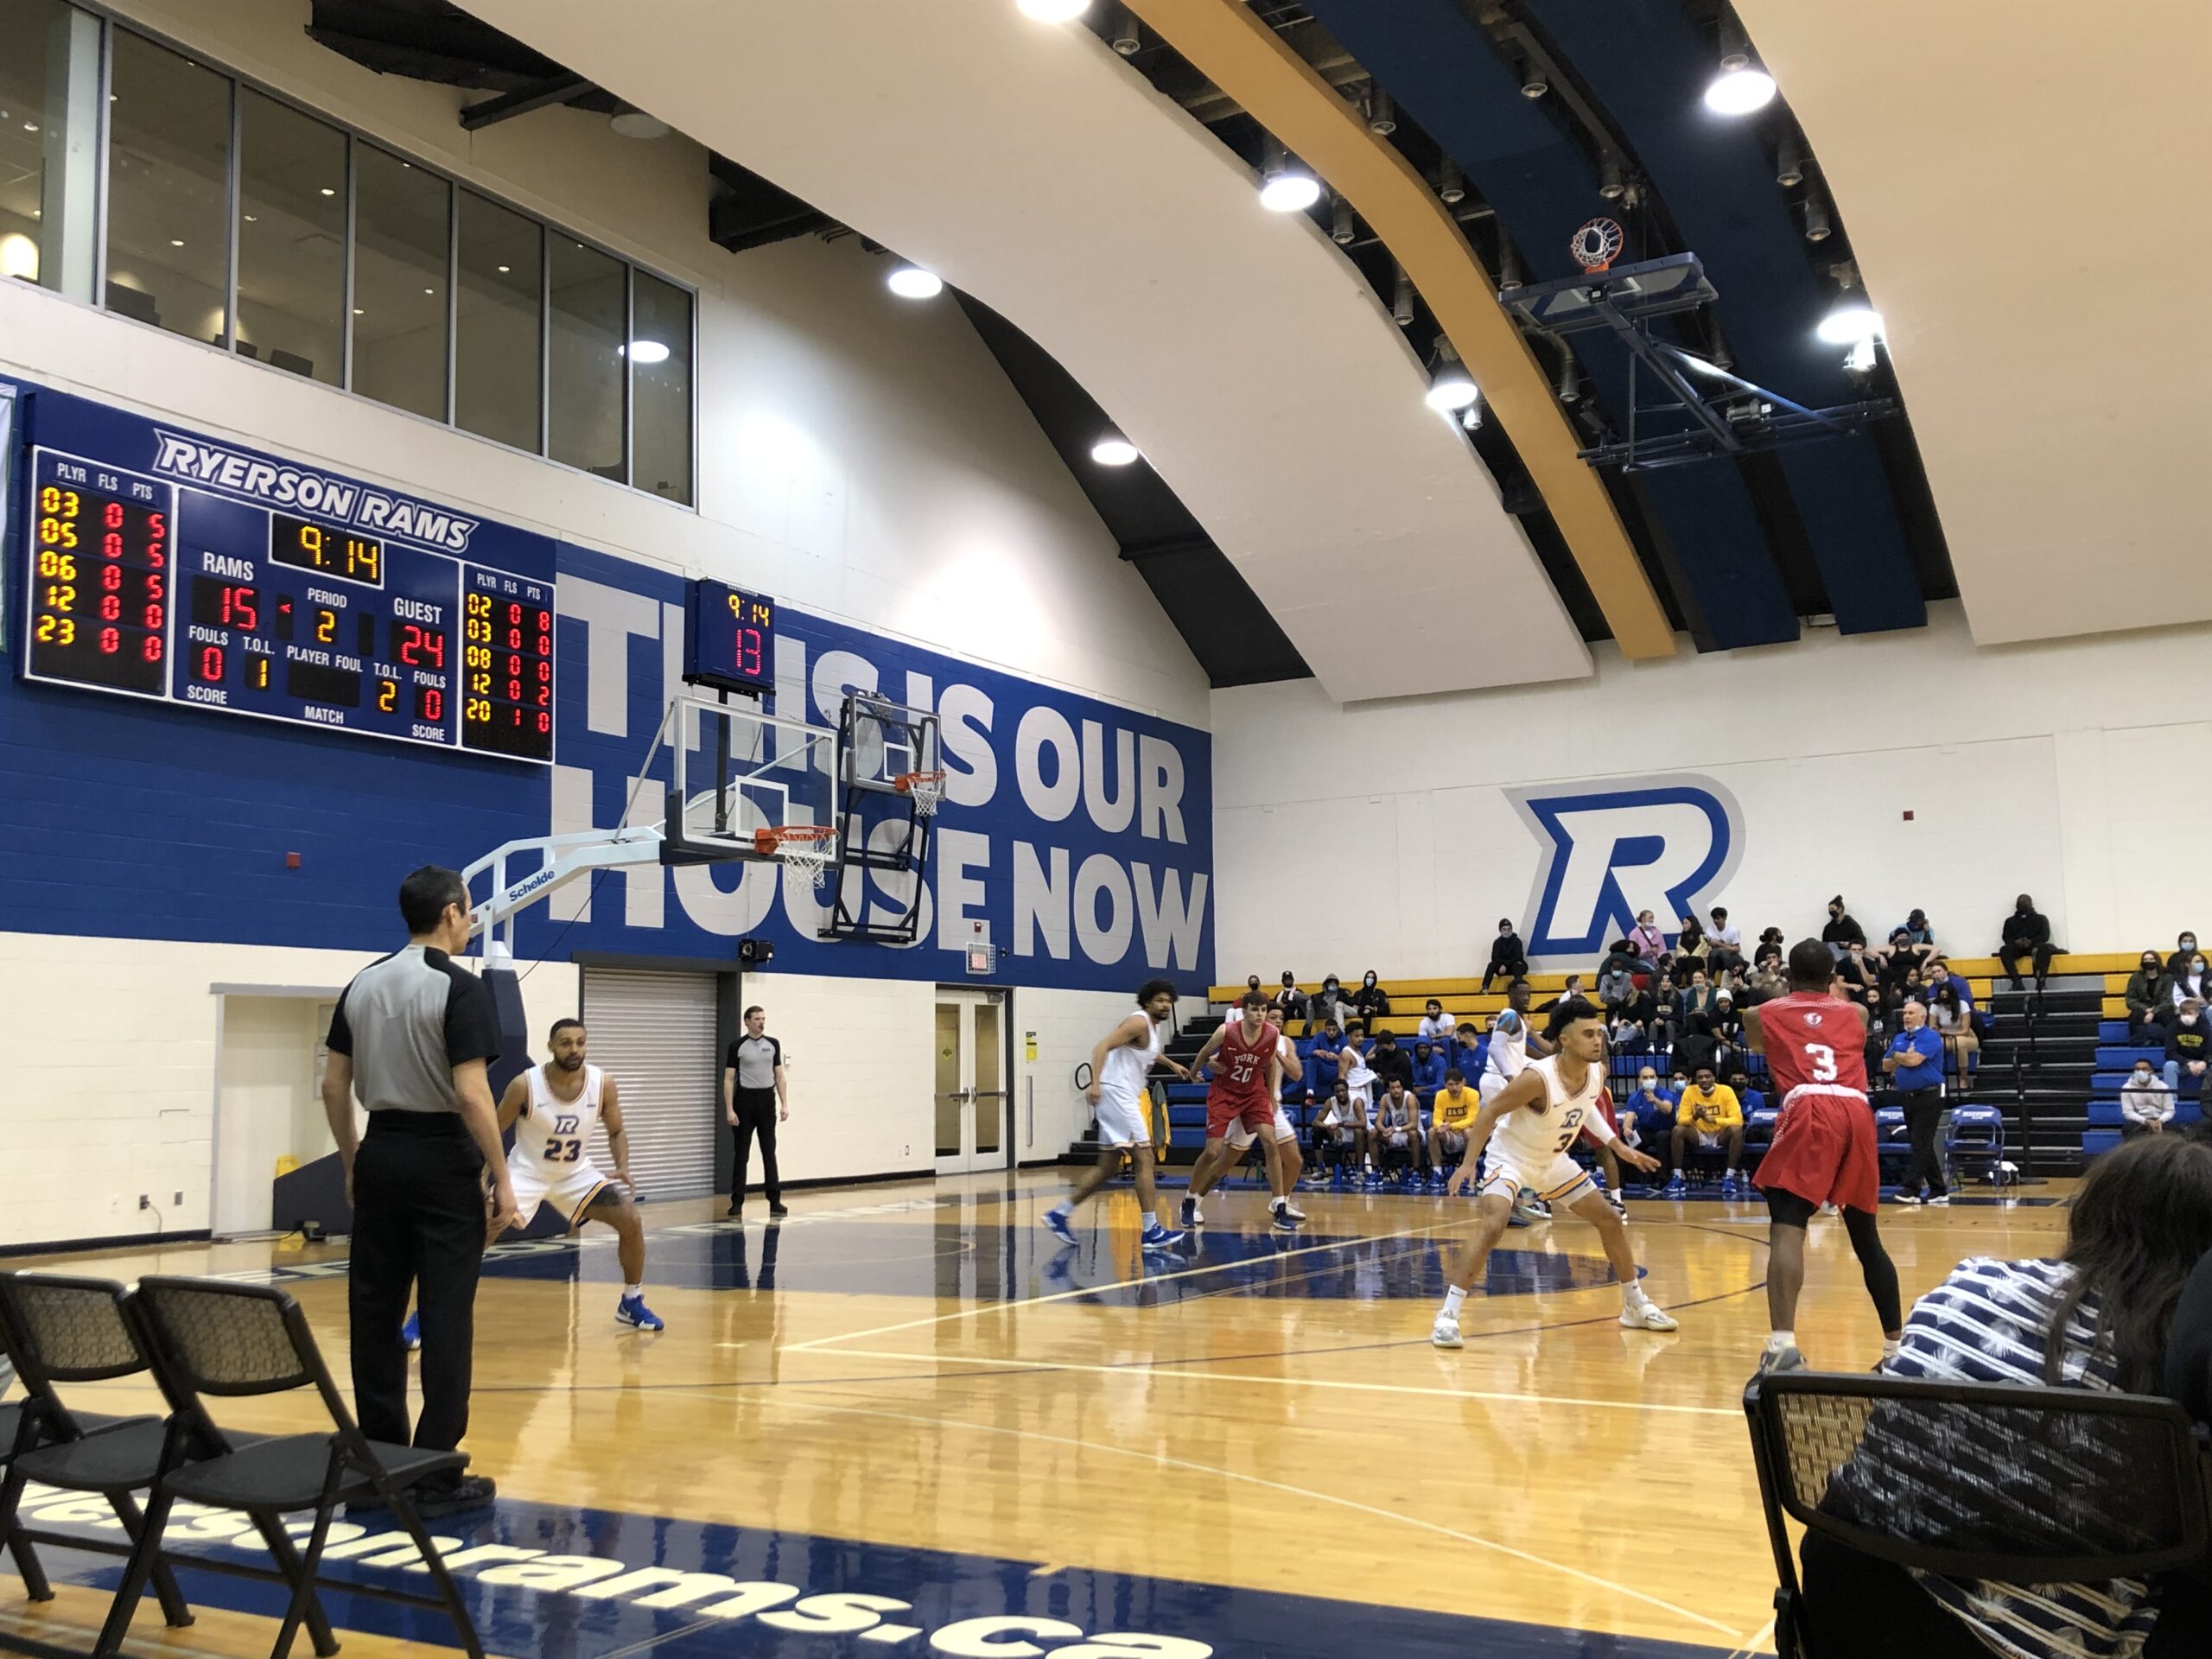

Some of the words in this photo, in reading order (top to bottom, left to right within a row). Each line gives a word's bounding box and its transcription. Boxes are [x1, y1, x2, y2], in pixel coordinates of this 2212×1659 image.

[57, 461, 86, 483] PLYR
[98, 474, 118, 491] FLS
[132, 482, 153, 500] PTS
[159, 435, 357, 518] RYERSON
[359, 495, 470, 550] RAMS
[42, 486, 79, 518] 03
[105, 502, 124, 528] 0
[149, 513, 165, 538] 5
[41, 518, 78, 548] 05
[104, 532, 123, 558] 0
[148, 543, 164, 568] 5
[301, 526, 378, 579] 9:14
[40, 550, 76, 581] 06
[103, 564, 122, 590] 0
[147, 574, 163, 600] 5
[202, 551, 254, 582] RAMS
[308, 588, 347, 608] PERIOD
[477, 573, 497, 589] PLYR
[504, 580, 518, 594] FLS
[527, 586, 541, 600] PTS
[48, 585, 76, 612] 12
[102, 594, 121, 620] 0
[145, 603, 162, 629] 0
[221, 587, 257, 631] 15
[394, 597, 442, 624] GUEST
[467, 593, 492, 617] 02
[509, 604, 521, 625] 0
[539, 611, 550, 632] 8
[728, 594, 770, 627] 9:14
[36, 614, 75, 645] 23
[100, 627, 119, 653] 0
[143, 635, 162, 661] 0
[188, 625, 229, 646] FOULS
[317, 610, 335, 643] 2
[467, 618, 492, 643] 03
[509, 628, 521, 649] 0
[538, 635, 550, 656] 0
[242, 636, 275, 655] T.O.L.
[286, 645, 330, 666] PLAYER
[335, 656, 363, 672] FOUL
[401, 625, 443, 667] 24
[736, 628, 760, 675] 13
[202, 646, 223, 681] 0
[258, 659, 268, 687] 1
[373, 663, 403, 680] T.O.L.
[413, 671, 447, 689] FOULS
[467, 645, 491, 669] 08
[509, 655, 521, 676] 0
[538, 661, 550, 682] 0
[187, 684, 227, 705] SCORE
[379, 681, 396, 711] 2
[424, 690, 442, 720] 0
[473, 673, 491, 695] 12
[509, 679, 521, 700] 0
[538, 686, 550, 706] 2
[304, 705, 344, 724] MATCH
[467, 698, 491, 721] 20
[515, 708, 521, 726] 1
[537, 712, 550, 733] 0
[556, 572, 882, 782] THIS
[906, 670, 998, 808] IS
[1014, 705, 1188, 845] OUR
[412, 724, 445, 741] SCORE
[549, 765, 991, 950] HOUSE
[1013, 840, 1209, 971] NOW
[1524, 785, 1732, 957] R
[508, 870, 556, 902] Schelde
[1230, 1065, 1254, 1084] 20
[1234, 1052, 1261, 1065] YORK
[1804, 1042, 1838, 1081] 3
[543, 1138, 582, 1162] 23
[1553, 1133, 1573, 1153] 3
